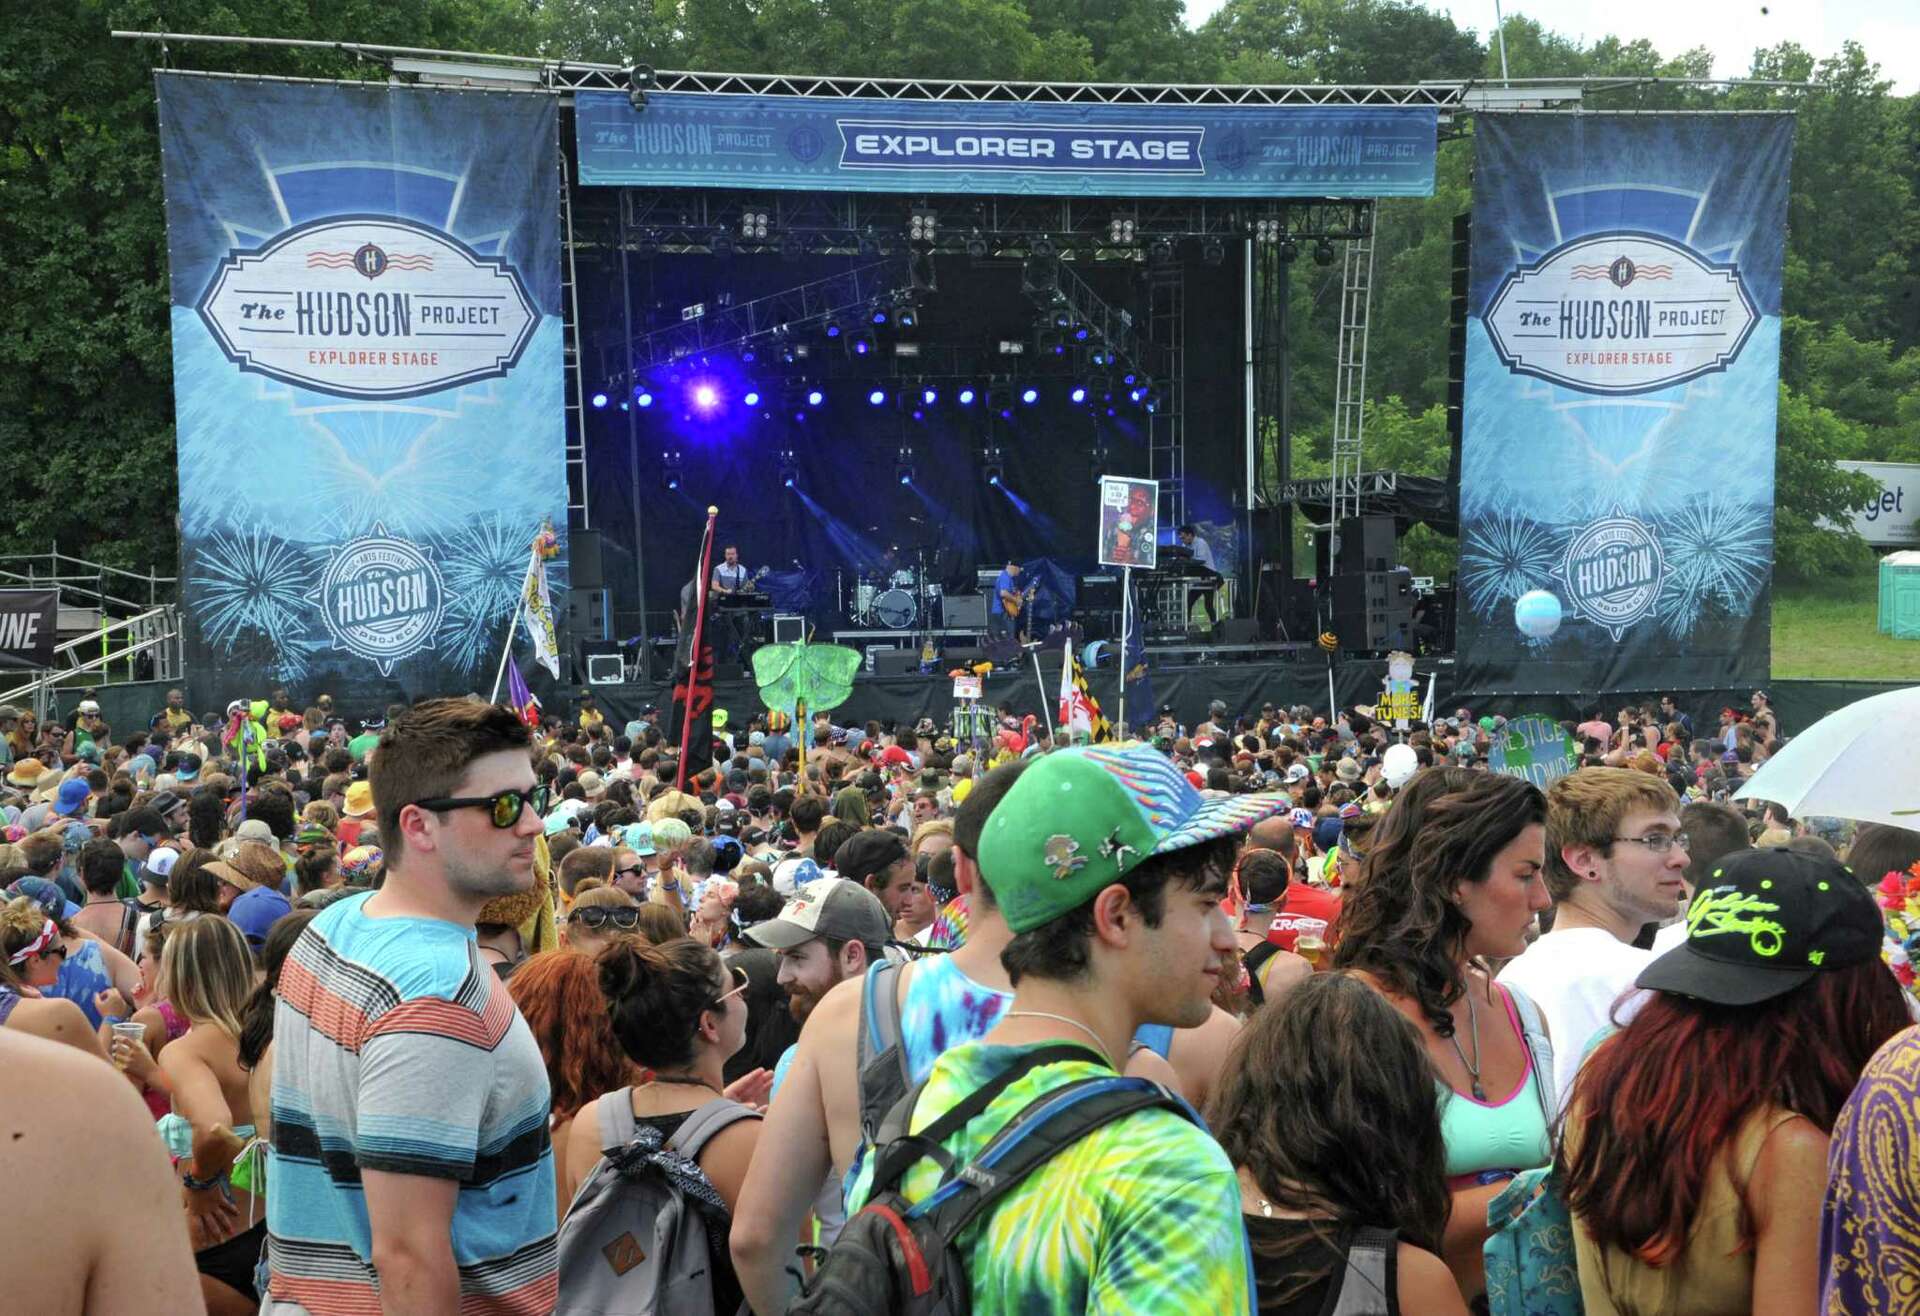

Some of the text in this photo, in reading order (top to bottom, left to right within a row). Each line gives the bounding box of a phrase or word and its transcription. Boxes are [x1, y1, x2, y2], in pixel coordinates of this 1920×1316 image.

[595, 122, 772, 155] The HUDSON PROJECT
[854, 133, 1055, 159] EXPLORER
[1070, 139, 1191, 161] STAGE
[1263, 144, 1290, 159] The
[1296, 134, 1363, 166] HUDSON
[1366, 142, 1417, 158] PROJECT
[240, 290, 500, 338] The HUDSON PROJECT
[1519, 299, 1726, 340] The HUDSON PROJECT
[308, 351, 438, 366] EXPLORER STAGE
[1566, 351, 1673, 365] EXPLORER STAGE
[1578, 545, 1651, 598] HUDSON
[338, 568, 428, 627] HUDSON
[1597, 590, 1645, 613] PROJECT
[359, 621, 419, 644] PROJECT
[1380, 692, 1418, 705] MORE
